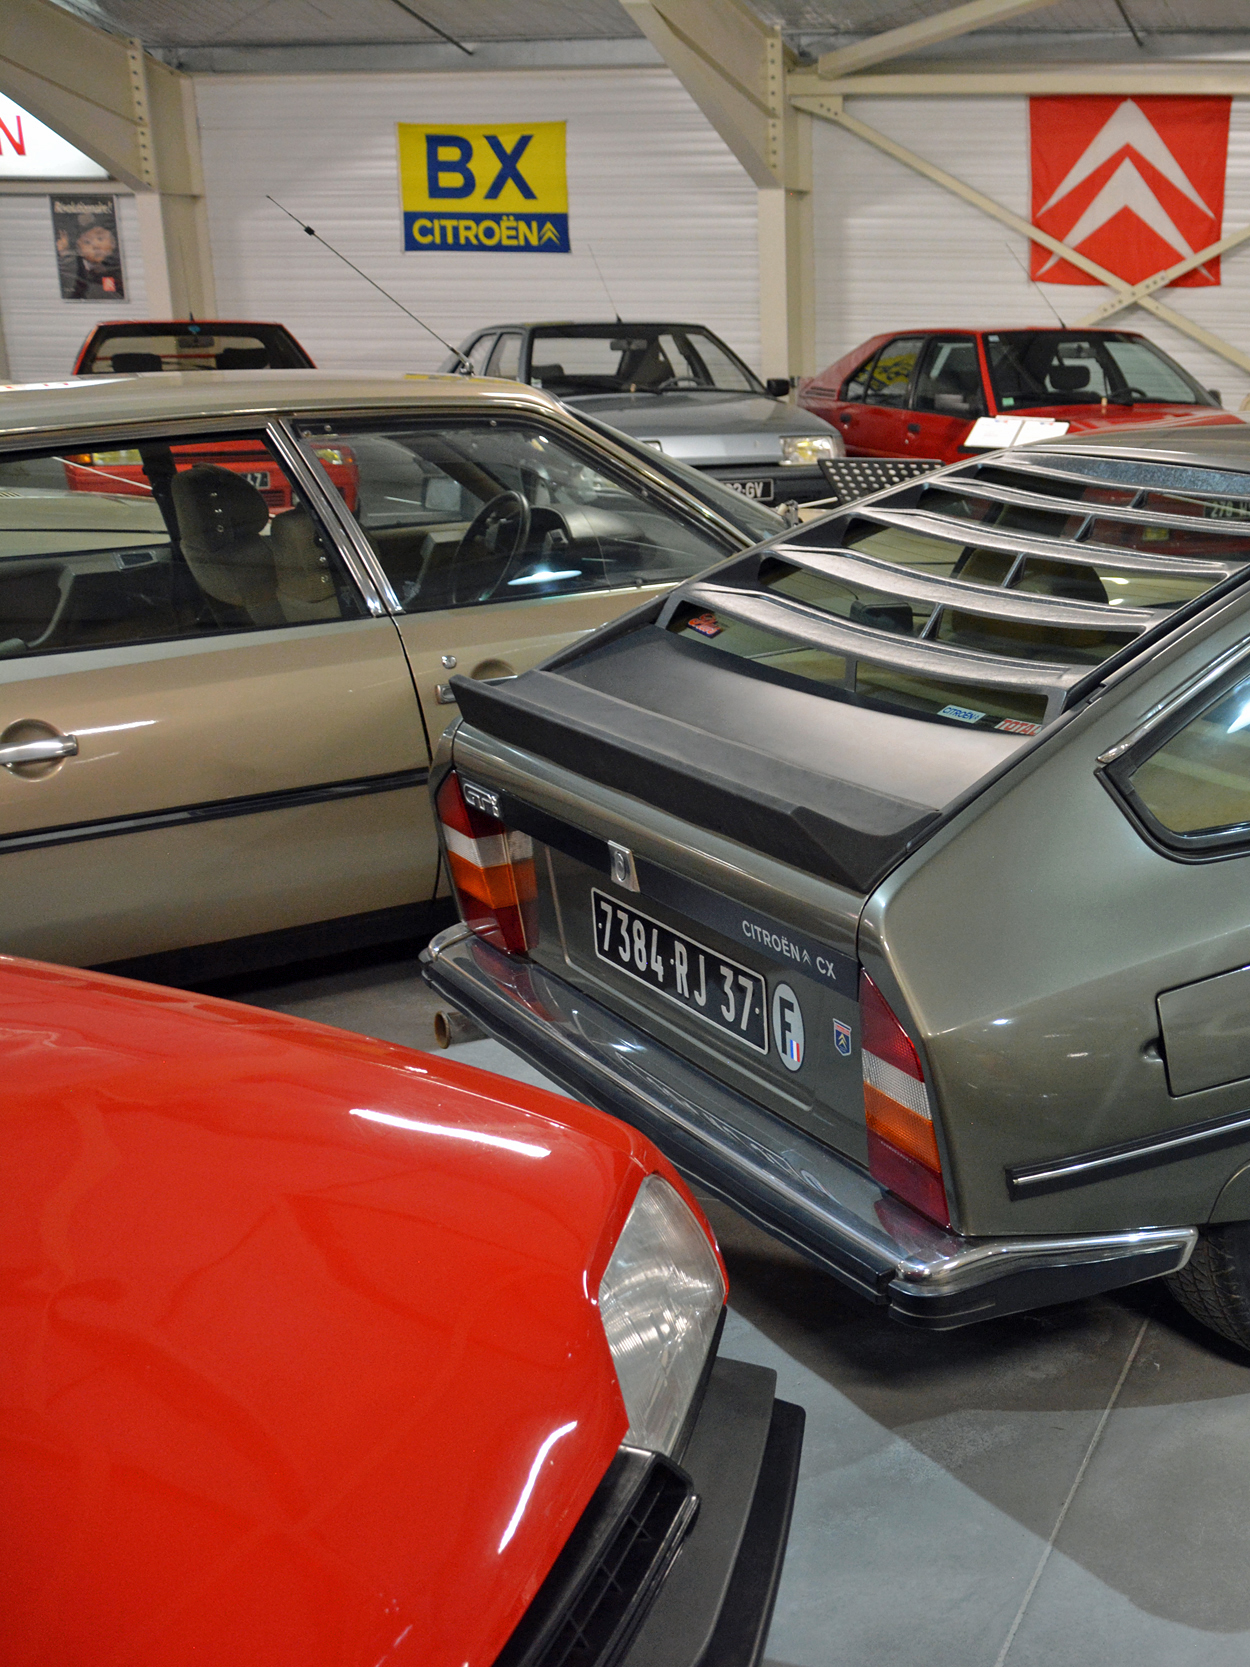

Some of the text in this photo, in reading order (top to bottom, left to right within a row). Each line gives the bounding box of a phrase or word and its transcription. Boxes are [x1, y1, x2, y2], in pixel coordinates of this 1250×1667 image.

[425, 133, 538, 200] BX
[412, 215, 539, 246] CITROËN
[998, 719, 1041, 736] TOTAL
[600, 901, 754, 1031] 7384 RJ 37
[742, 920, 837, 980] CITROËN CX
[778, 996, 795, 1056] F
